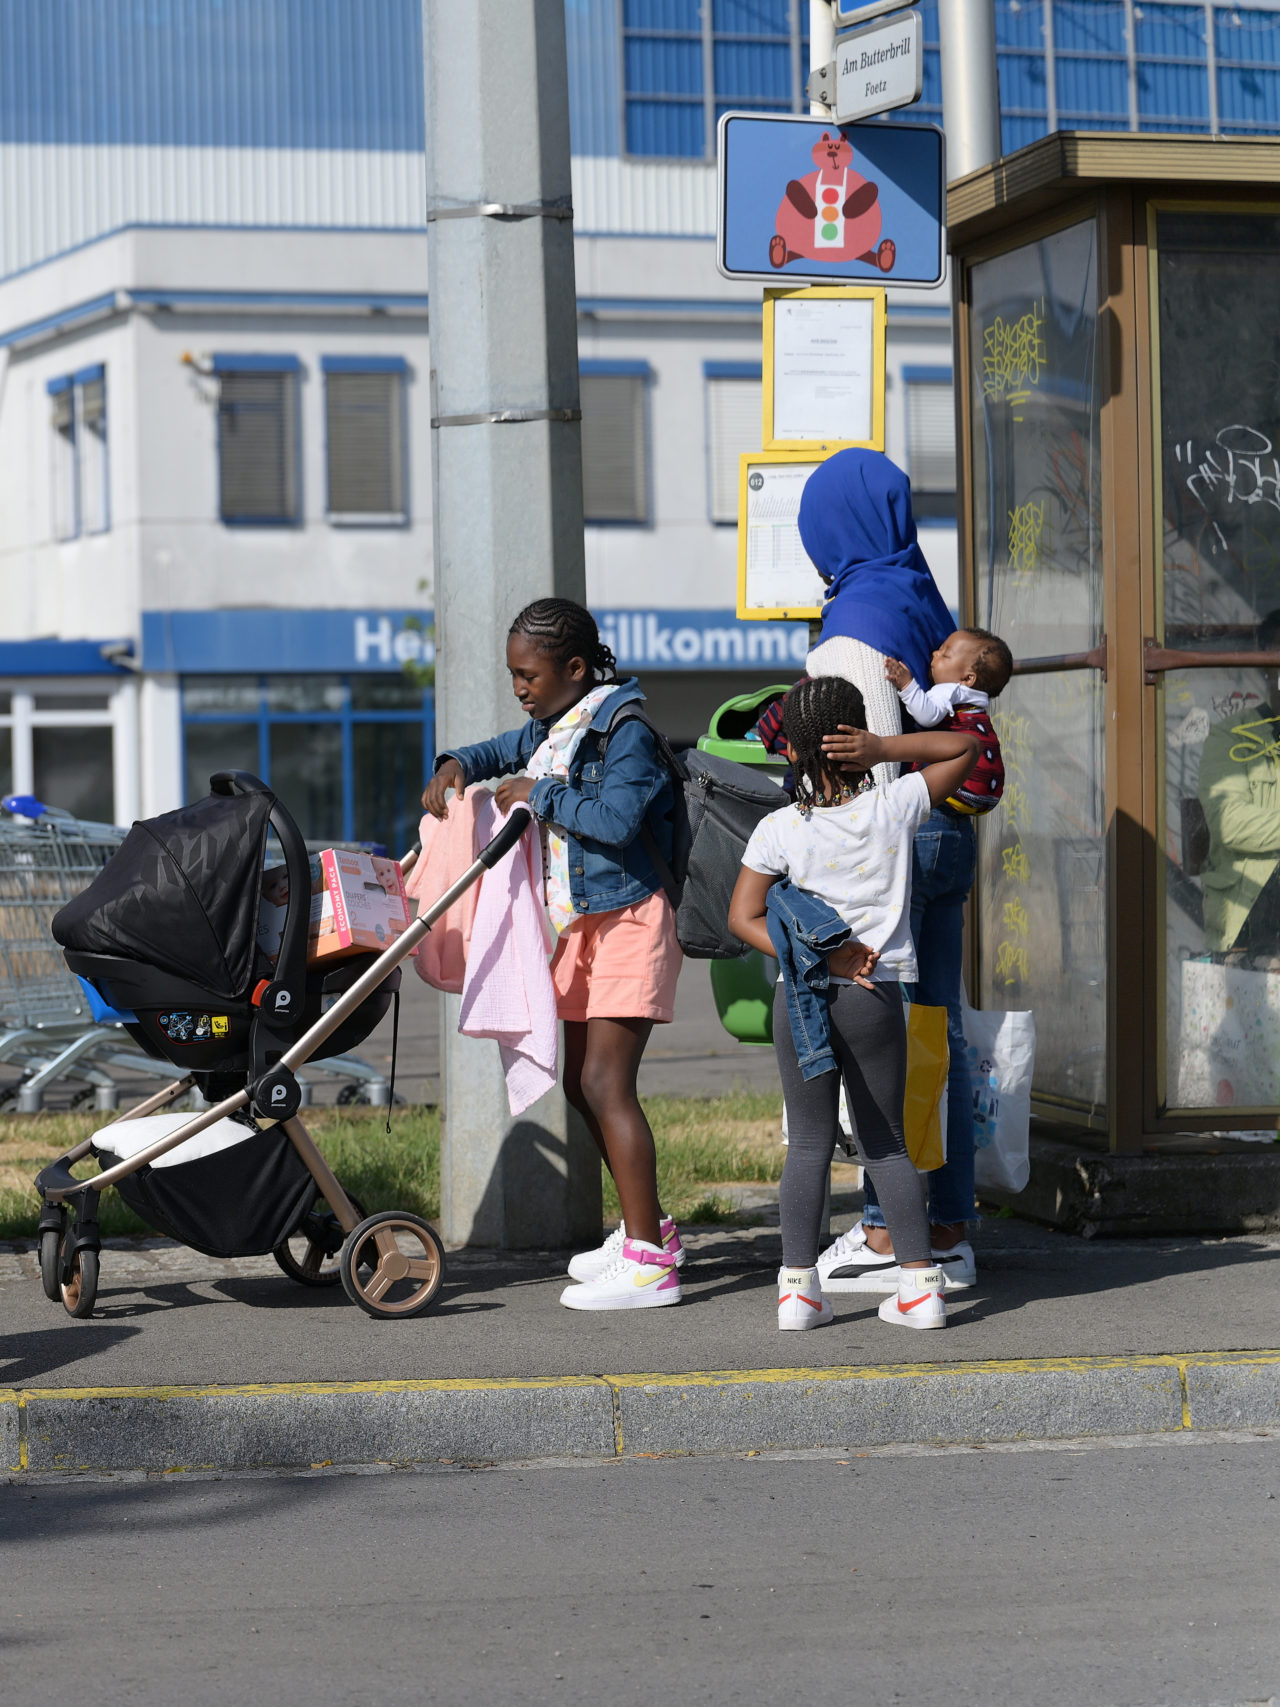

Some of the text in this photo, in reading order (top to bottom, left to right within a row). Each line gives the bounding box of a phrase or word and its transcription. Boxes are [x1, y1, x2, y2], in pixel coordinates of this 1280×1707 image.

[842, 37, 911, 76] Am Butterbrill
[865, 80, 887, 97] Foetz
[598, 613, 809, 662] illkomme
[328, 866, 347, 932] ECONOMY PACK
[787, 1277, 802, 1285] NIKE
[924, 1275, 939, 1284] NIKE
